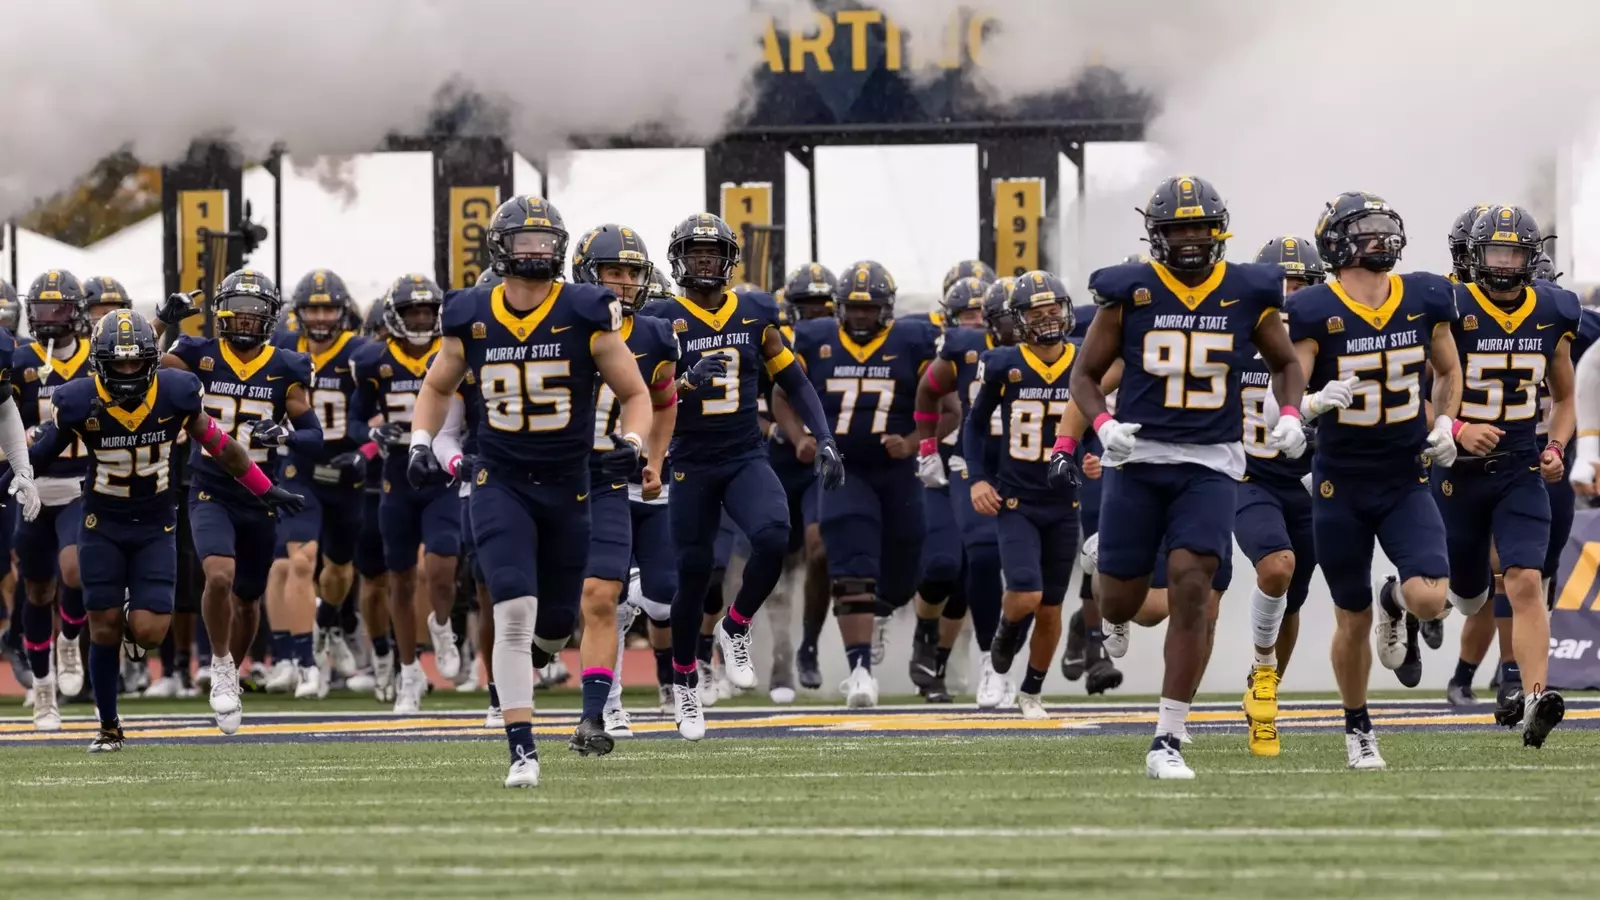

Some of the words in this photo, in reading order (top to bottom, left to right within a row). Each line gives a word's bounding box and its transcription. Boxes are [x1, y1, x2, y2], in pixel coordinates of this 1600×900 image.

[686, 335, 723, 352] MURRAY
[726, 332, 750, 345] STATE
[1154, 315, 1197, 329] MURRAY
[1199, 315, 1228, 331] STATE
[1346, 335, 1387, 354] MURRAY
[1390, 329, 1418, 347] STATE
[485, 346, 528, 362] MURRAY
[531, 343, 561, 359] STATE
[1476, 338, 1515, 351] MURRAY
[1518, 338, 1543, 351] STATE
[701, 347, 740, 415] 3
[833, 365, 866, 377] MURRAY
[867, 366, 891, 378] STATE
[1143, 330, 1235, 409] 95
[1240, 371, 1270, 385] MURR
[1337, 345, 1425, 427] 55
[1460, 352, 1547, 421] 53
[210, 380, 247, 397] MURRAY
[248, 387, 273, 399] STATE
[480, 360, 572, 432] 85
[826, 378, 896, 434] 77
[1019, 388, 1053, 400] MURRAY
[1054, 388, 1071, 400] STA
[311, 388, 347, 441] 0
[385, 392, 418, 445] 2
[1241, 386, 1281, 459] 8
[101, 435, 138, 448] MURRAY
[141, 429, 167, 444] STATE
[93, 440, 173, 498] 24
